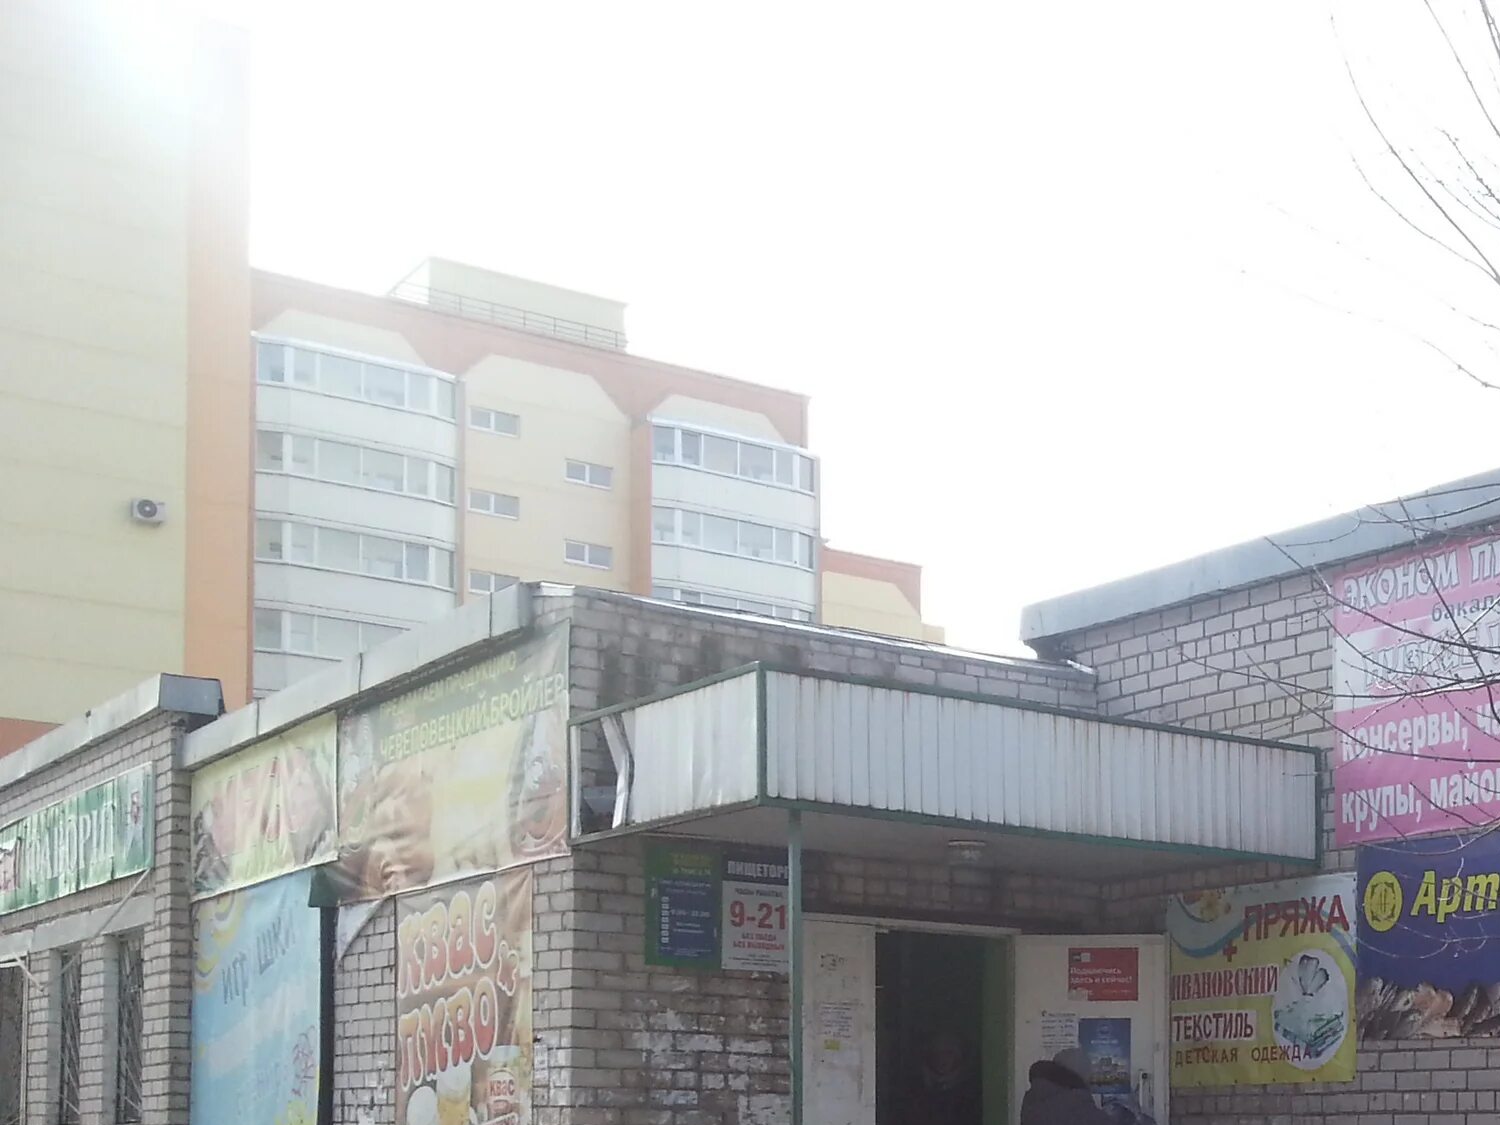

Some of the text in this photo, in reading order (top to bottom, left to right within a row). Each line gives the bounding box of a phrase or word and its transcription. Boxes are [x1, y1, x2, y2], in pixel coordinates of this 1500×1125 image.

[1341, 550, 1460, 614] ЭКОНОМ
[490, 672, 565, 724] БРОЙЛЕР
[1342, 709, 1467, 761] консервы,
[1342, 782, 1422, 832] крупы,
[730, 900, 786, 930] 9-21
[1243, 894, 1349, 942] ПРЯЖА
[222, 906, 296, 1006] ИГРШКИ
[1172, 966, 1280, 1000] ИВАНОВСКИЙ
[1173, 1012, 1253, 1042] ТЕКСТИЛЬ
[1175, 1044, 1312, 1067] ДЕТСКАЯ ОДЕЖДА
